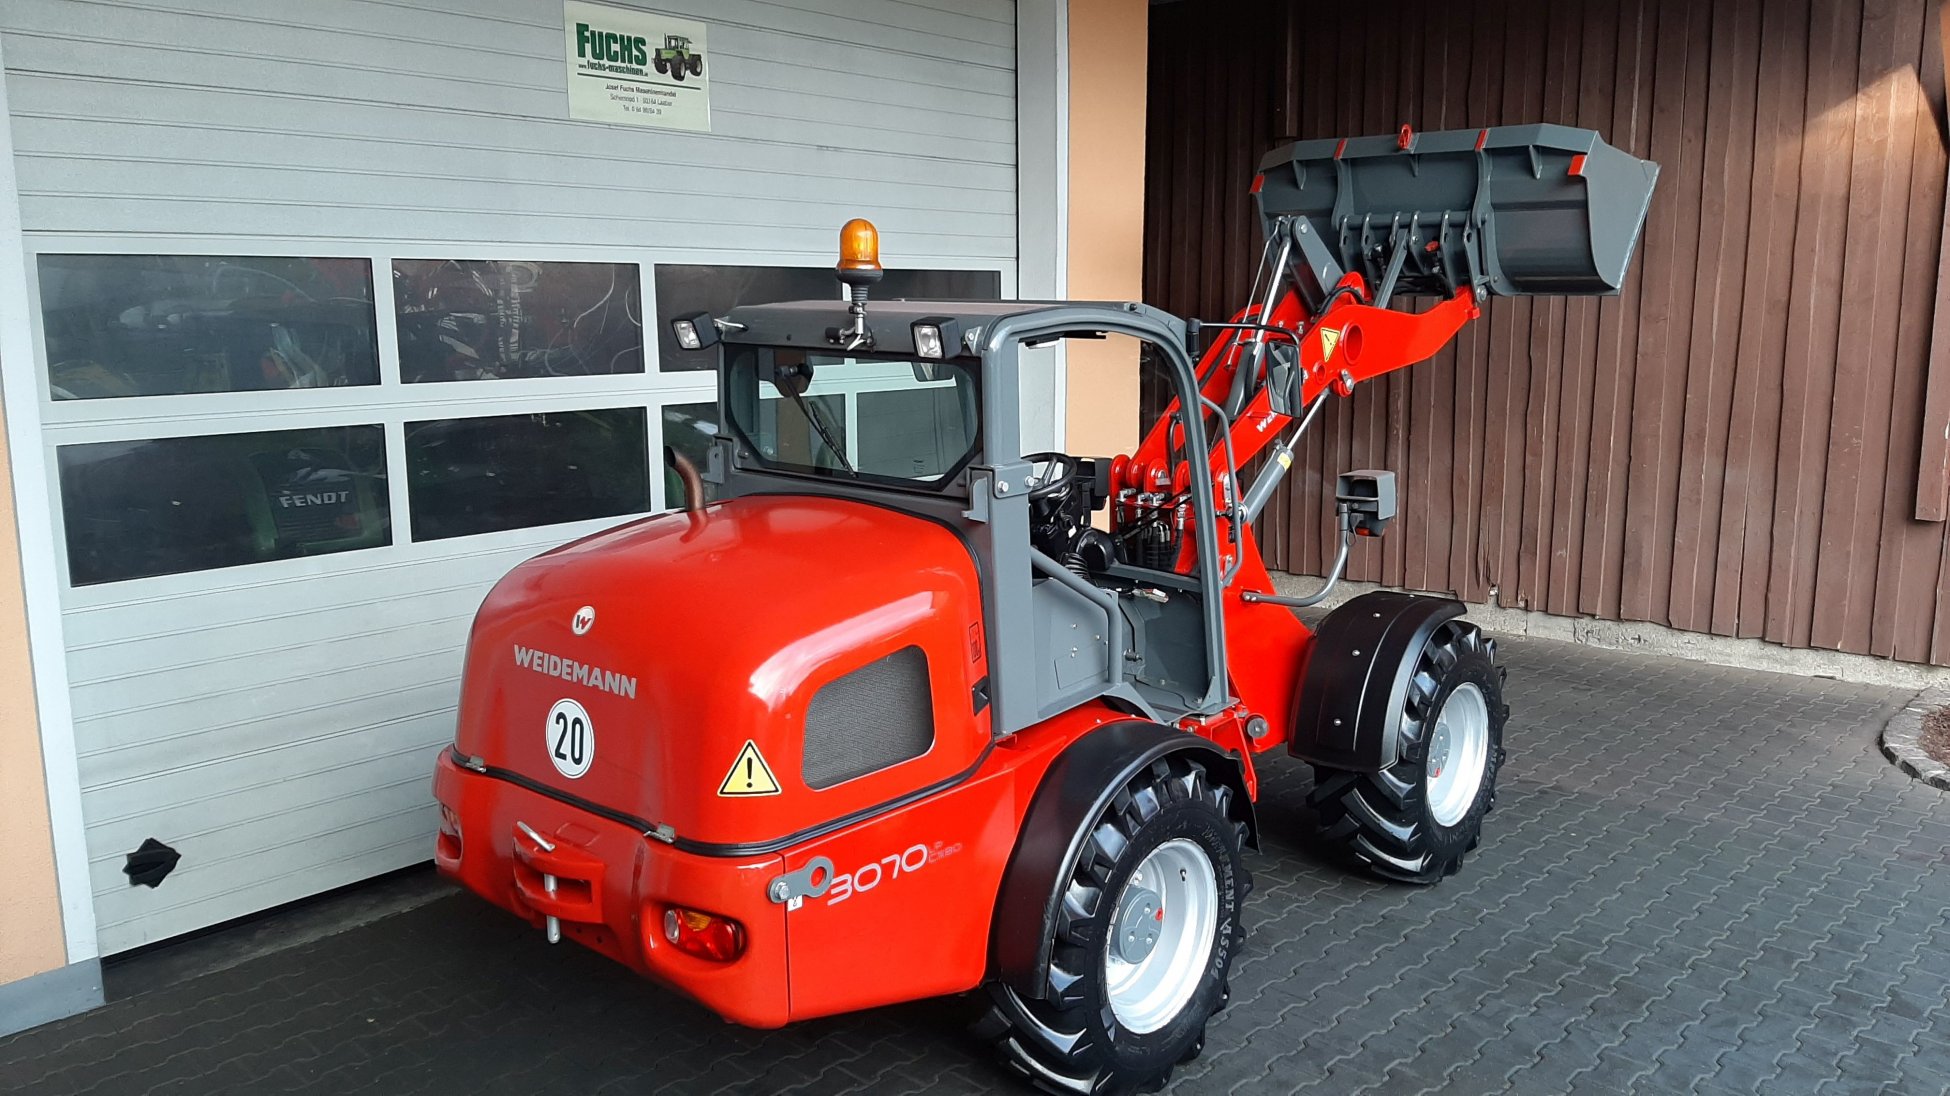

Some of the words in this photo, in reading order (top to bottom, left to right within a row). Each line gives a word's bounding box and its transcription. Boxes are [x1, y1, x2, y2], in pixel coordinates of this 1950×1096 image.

[576, 23, 648, 66] FUCHS
[279, 491, 349, 507] FENDT
[514, 644, 637, 699] WEIDEMANN
[555, 712, 584, 765] 20
[827, 844, 928, 906] 3070
